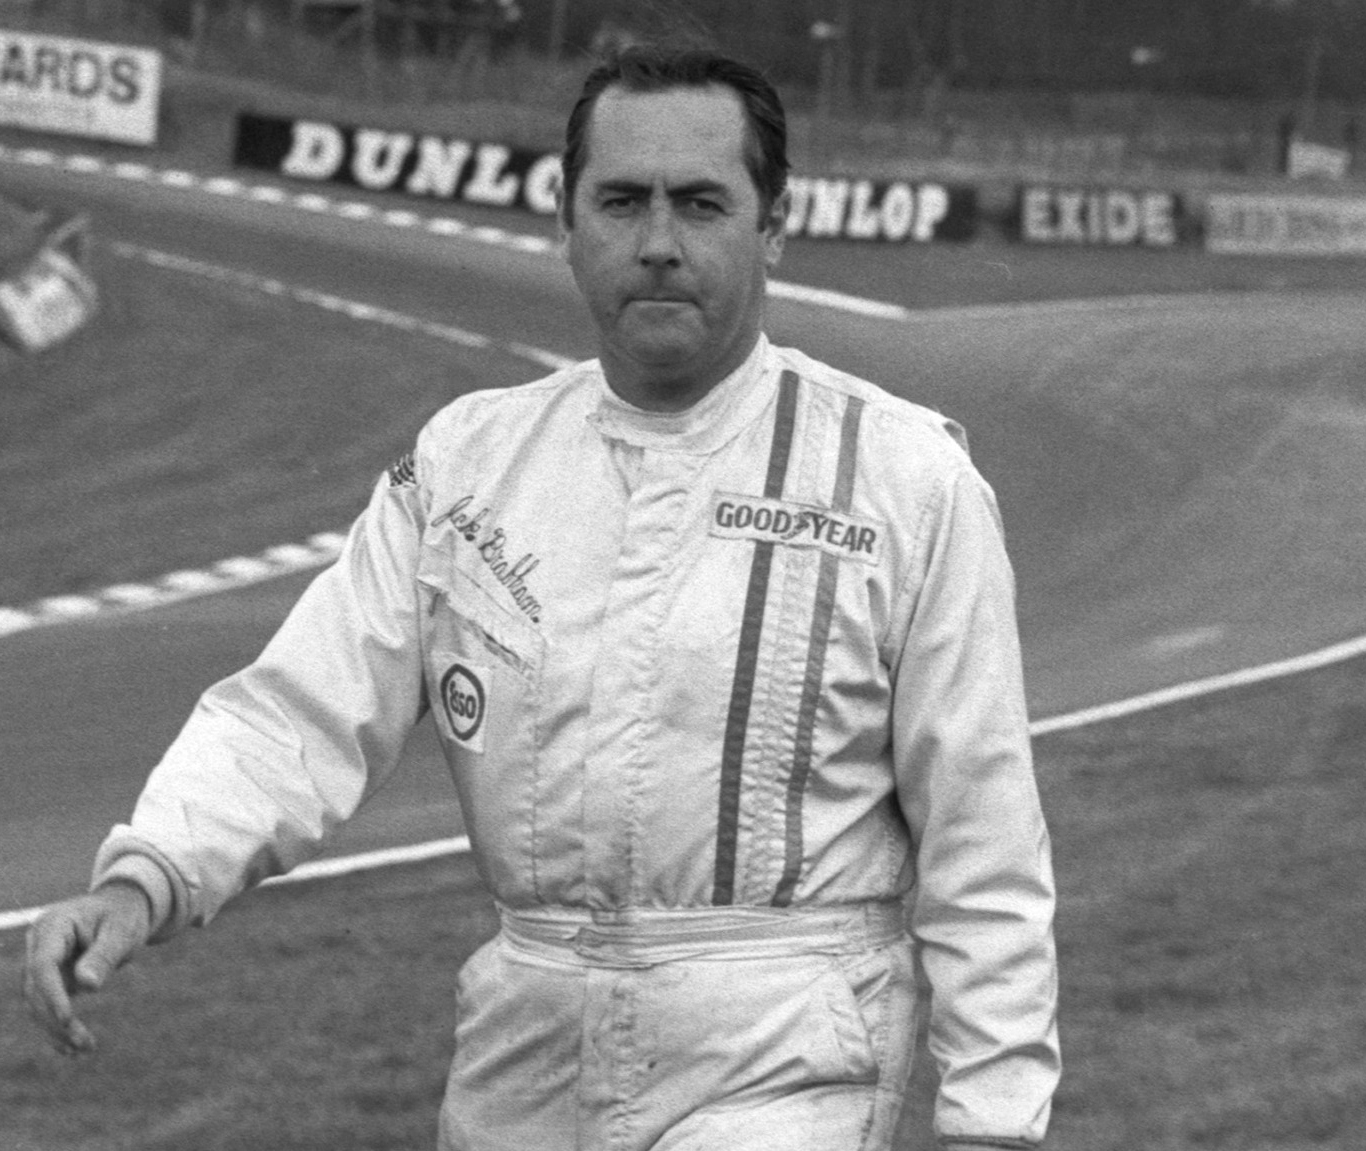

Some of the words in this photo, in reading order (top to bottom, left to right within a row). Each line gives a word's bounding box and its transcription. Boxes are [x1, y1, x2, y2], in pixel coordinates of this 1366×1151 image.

[281, 120, 564, 214] DUNLO
[786, 177, 948, 241] UNLOP
[1023, 190, 1176, 245] EXIDE
